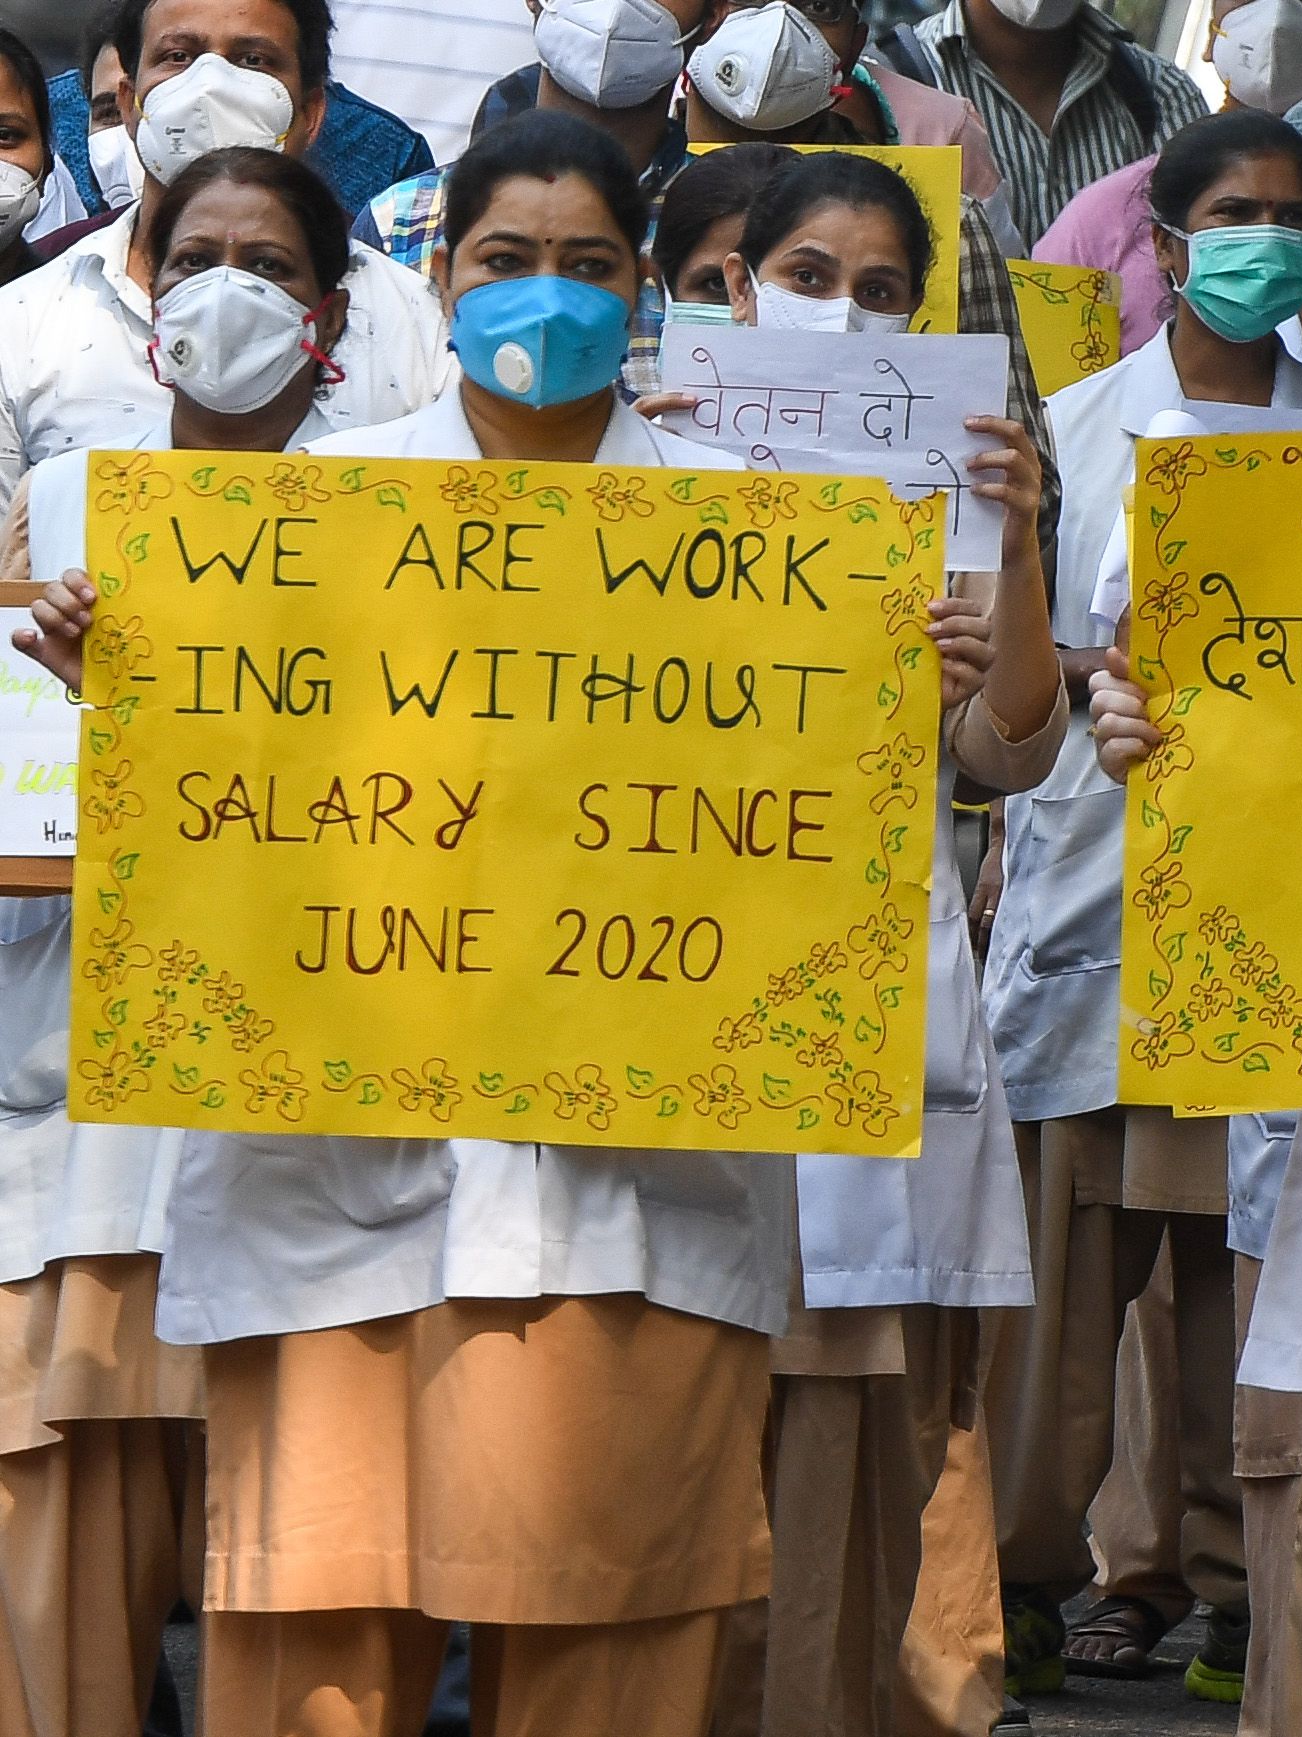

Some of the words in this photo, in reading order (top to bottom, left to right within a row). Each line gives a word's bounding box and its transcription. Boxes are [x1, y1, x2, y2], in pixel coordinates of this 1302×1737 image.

[683, 347, 840, 437] वेतन
[859, 358, 934, 447] दो
[171, 516, 318, 588] WE
[385, 520, 546, 593] ARE
[380, 648, 848, 734] WITHOUT
[178, 771, 484, 851] SALARY
[574, 783, 834, 863] SINCE
[295, 905, 496, 975] JUNE
[545, 908, 724, 983] 2020
